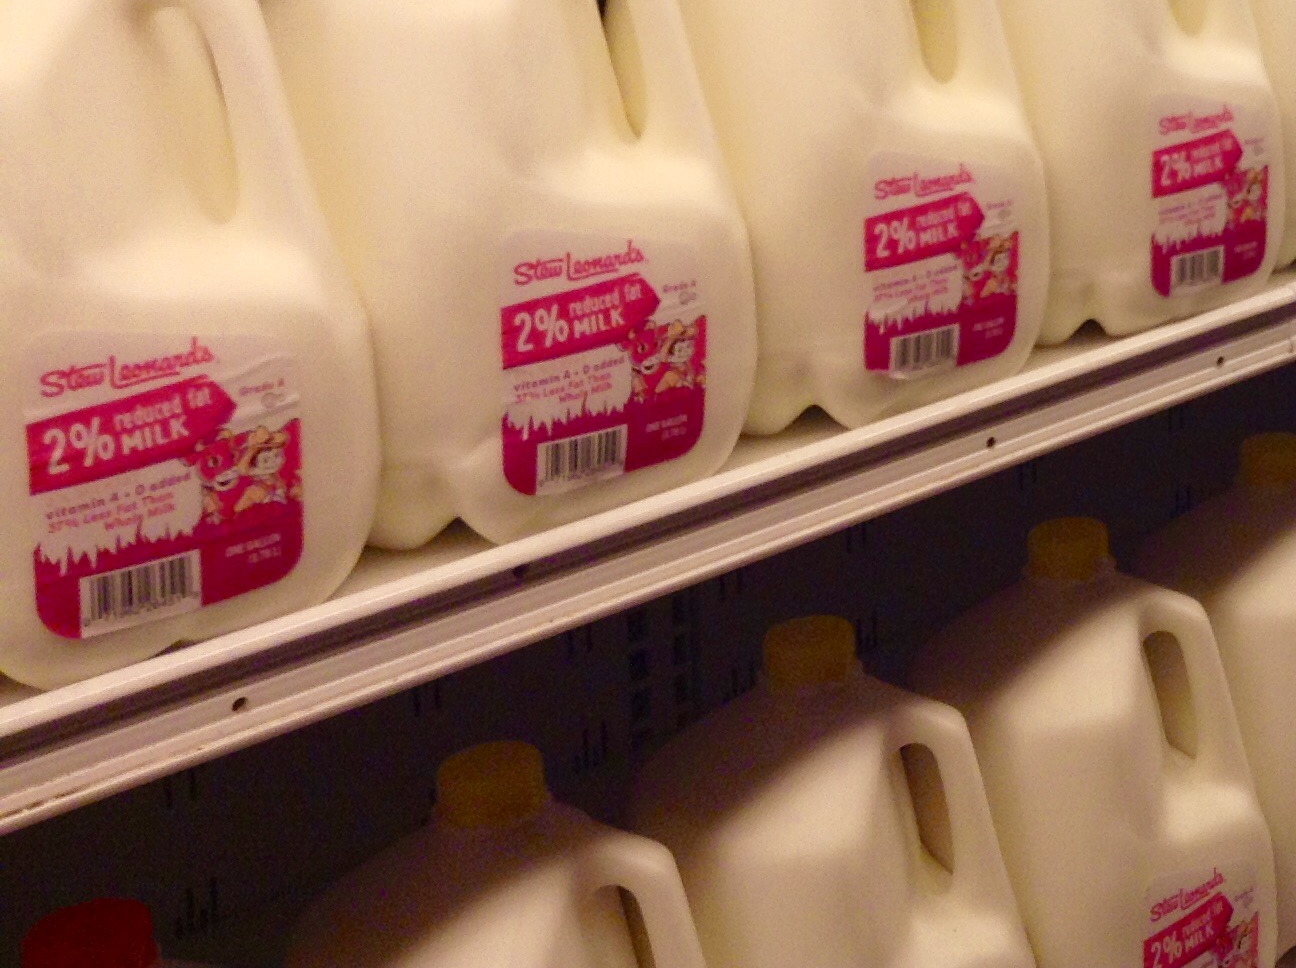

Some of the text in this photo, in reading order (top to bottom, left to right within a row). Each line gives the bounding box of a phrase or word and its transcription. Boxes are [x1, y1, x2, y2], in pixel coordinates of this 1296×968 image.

[1160, 150, 1192, 186] 2%
[873, 216, 917, 258] 2%
[919, 222, 958, 247] MILK
[513, 258, 563, 286] Stew
[569, 287, 621, 318] reduced
[513, 303, 570, 352] 2%
[573, 307, 626, 340] MILK
[39, 363, 105, 398] Stew
[113, 394, 182, 431] reduced
[42, 417, 115, 475] 2%
[121, 415, 190, 456] MILK
[1151, 930, 1183, 968] 2%
